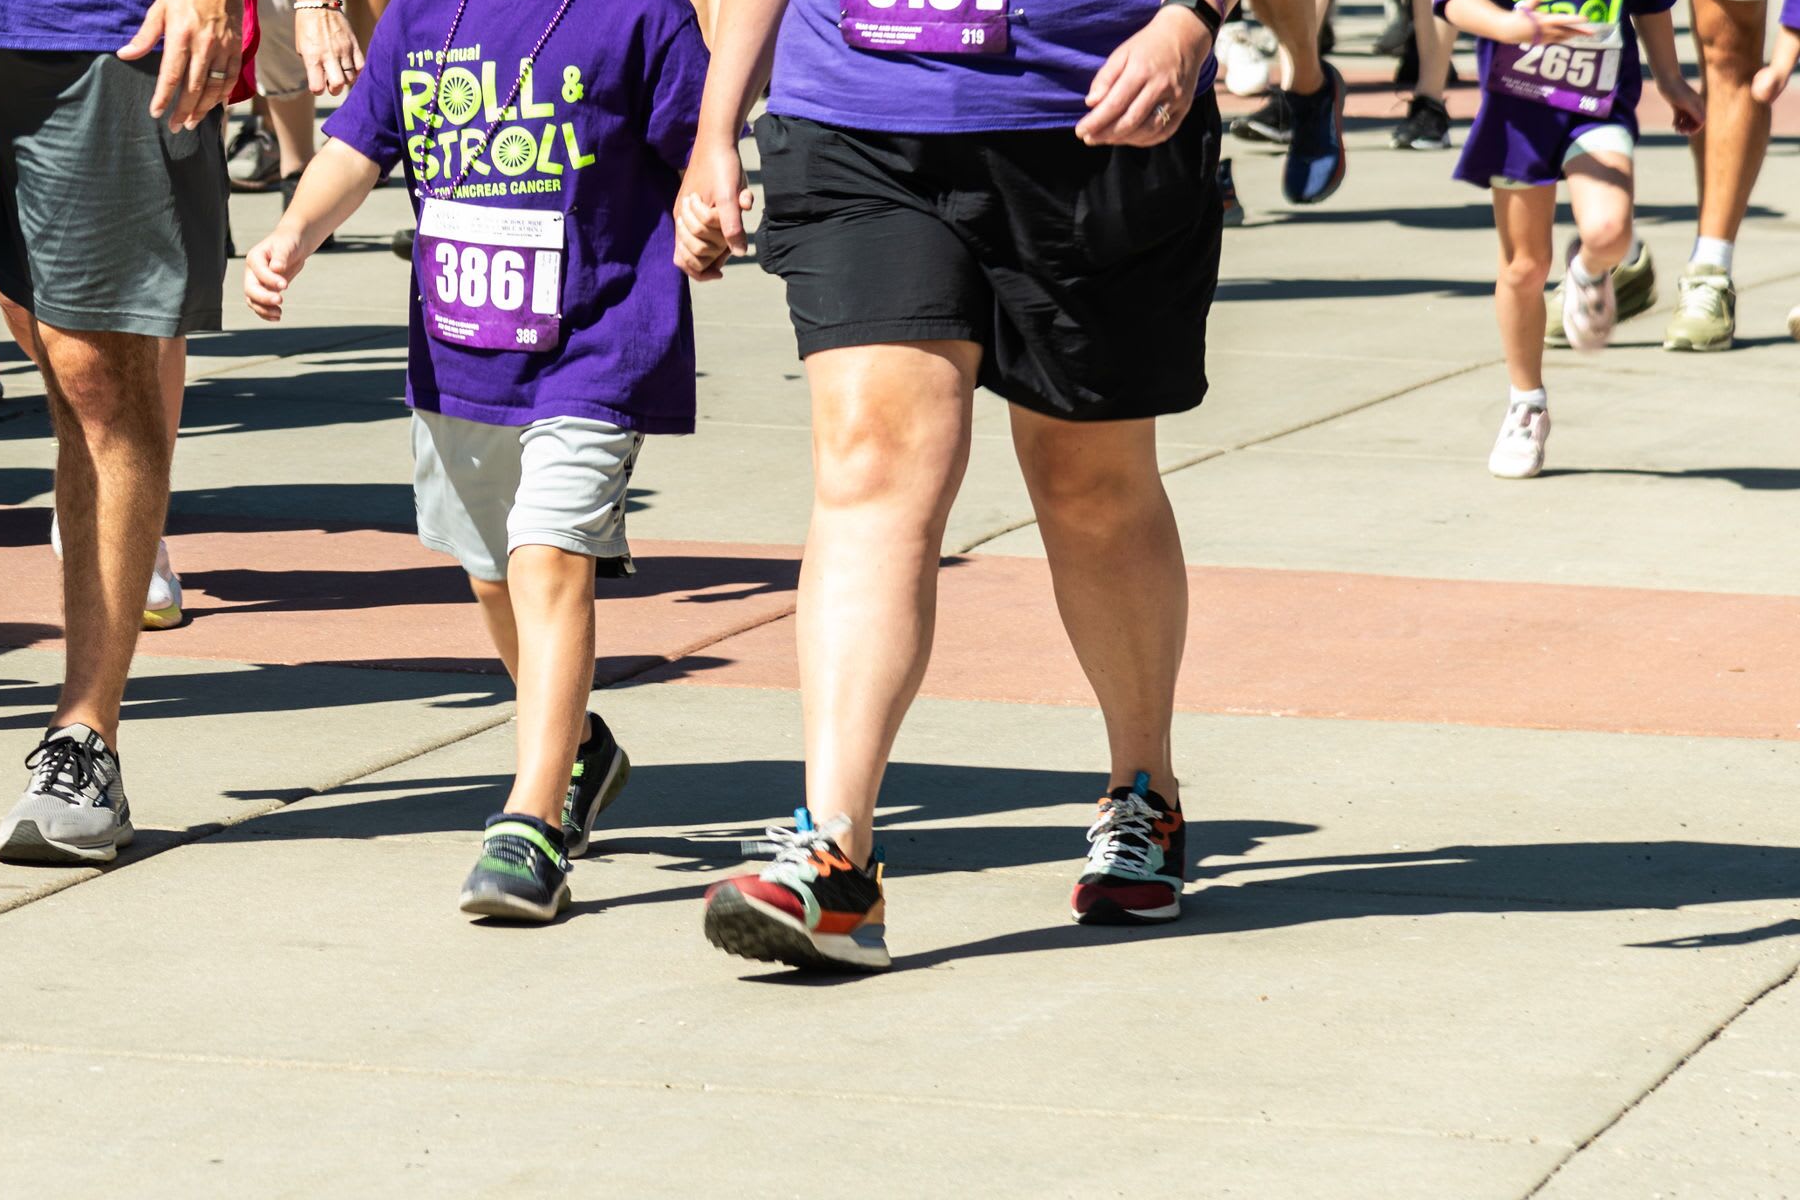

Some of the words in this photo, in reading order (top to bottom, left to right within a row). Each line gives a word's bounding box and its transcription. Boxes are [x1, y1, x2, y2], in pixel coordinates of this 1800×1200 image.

[961, 28, 985, 44] 319
[1512, 43, 1597, 88] 265
[400, 57, 555, 131] ROLL
[561, 65, 584, 103] &
[407, 122, 596, 181] STROLL
[510, 179, 561, 195] CANCER
[435, 242, 525, 311] 386
[516, 328, 538, 344] 386
